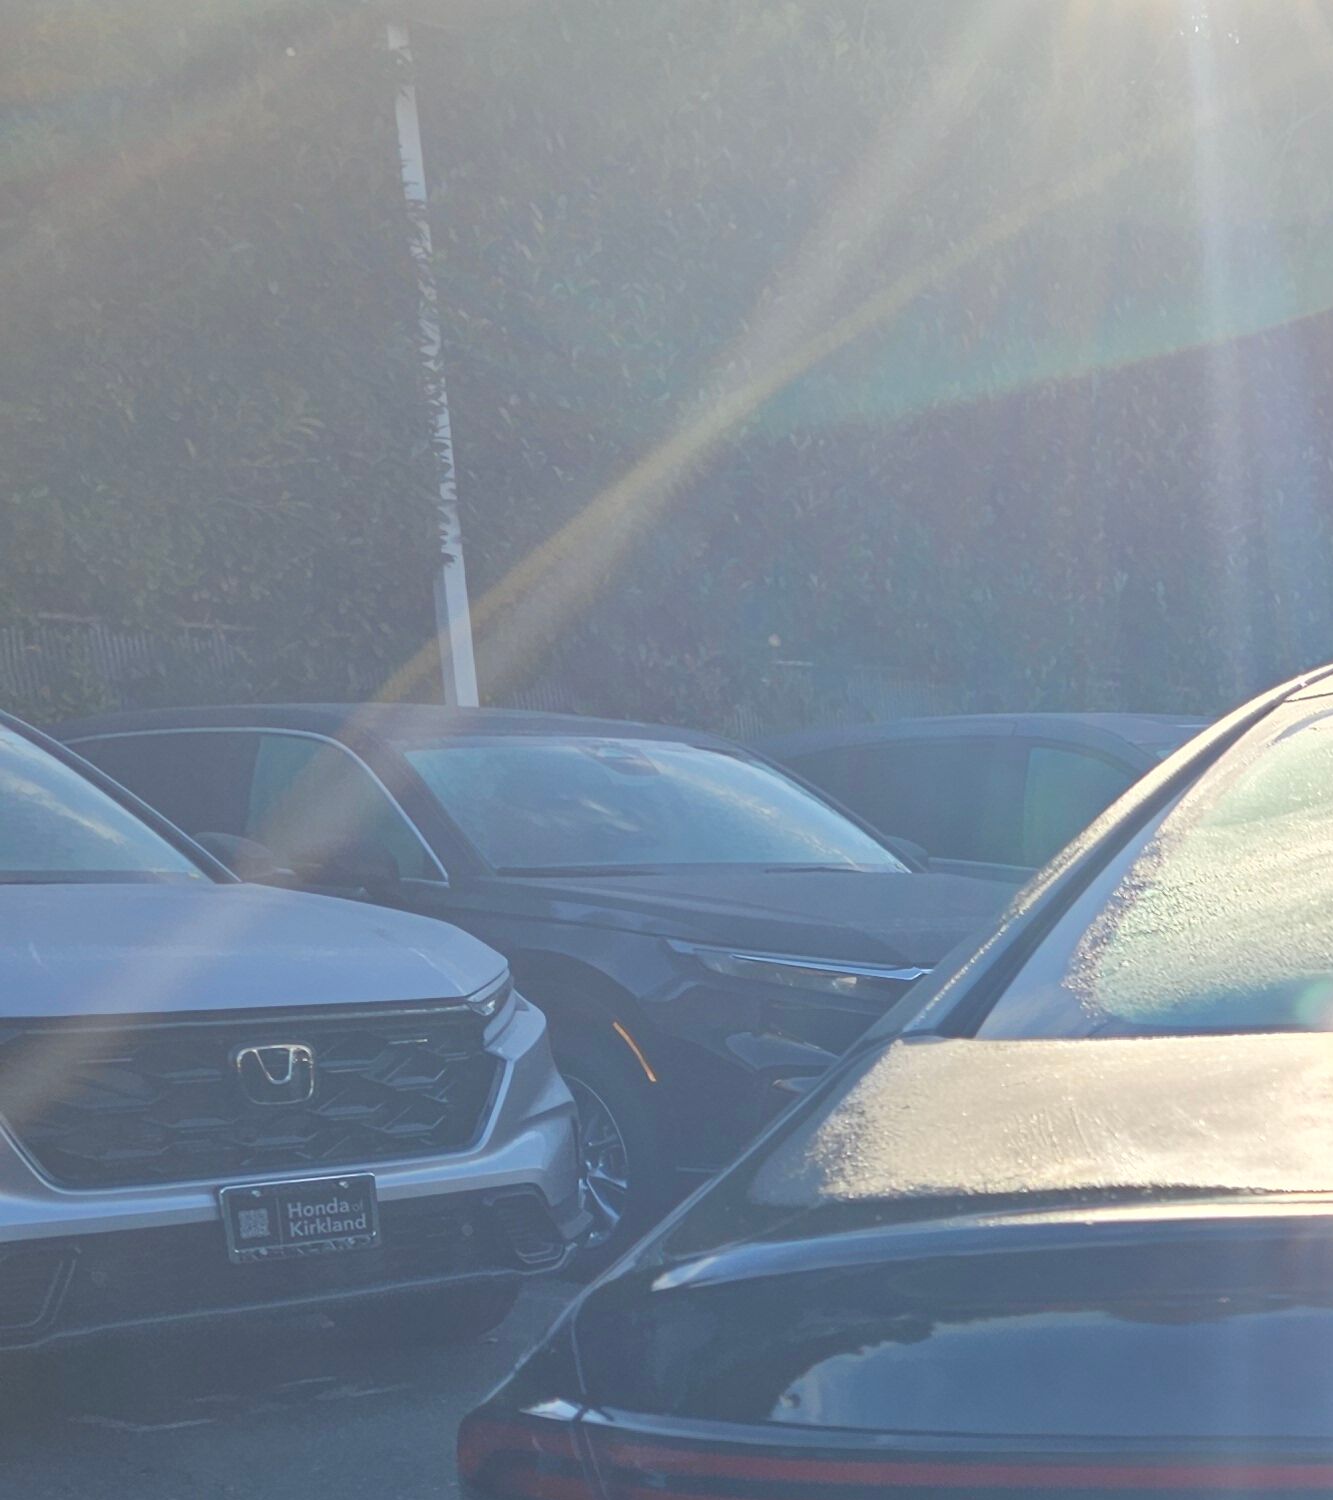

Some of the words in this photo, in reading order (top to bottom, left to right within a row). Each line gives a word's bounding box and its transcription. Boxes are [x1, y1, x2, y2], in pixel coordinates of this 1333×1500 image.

[287, 1198, 350, 1219] Honda
[352, 1200, 364, 1212] of
[289, 1214, 367, 1237] Kirkland
